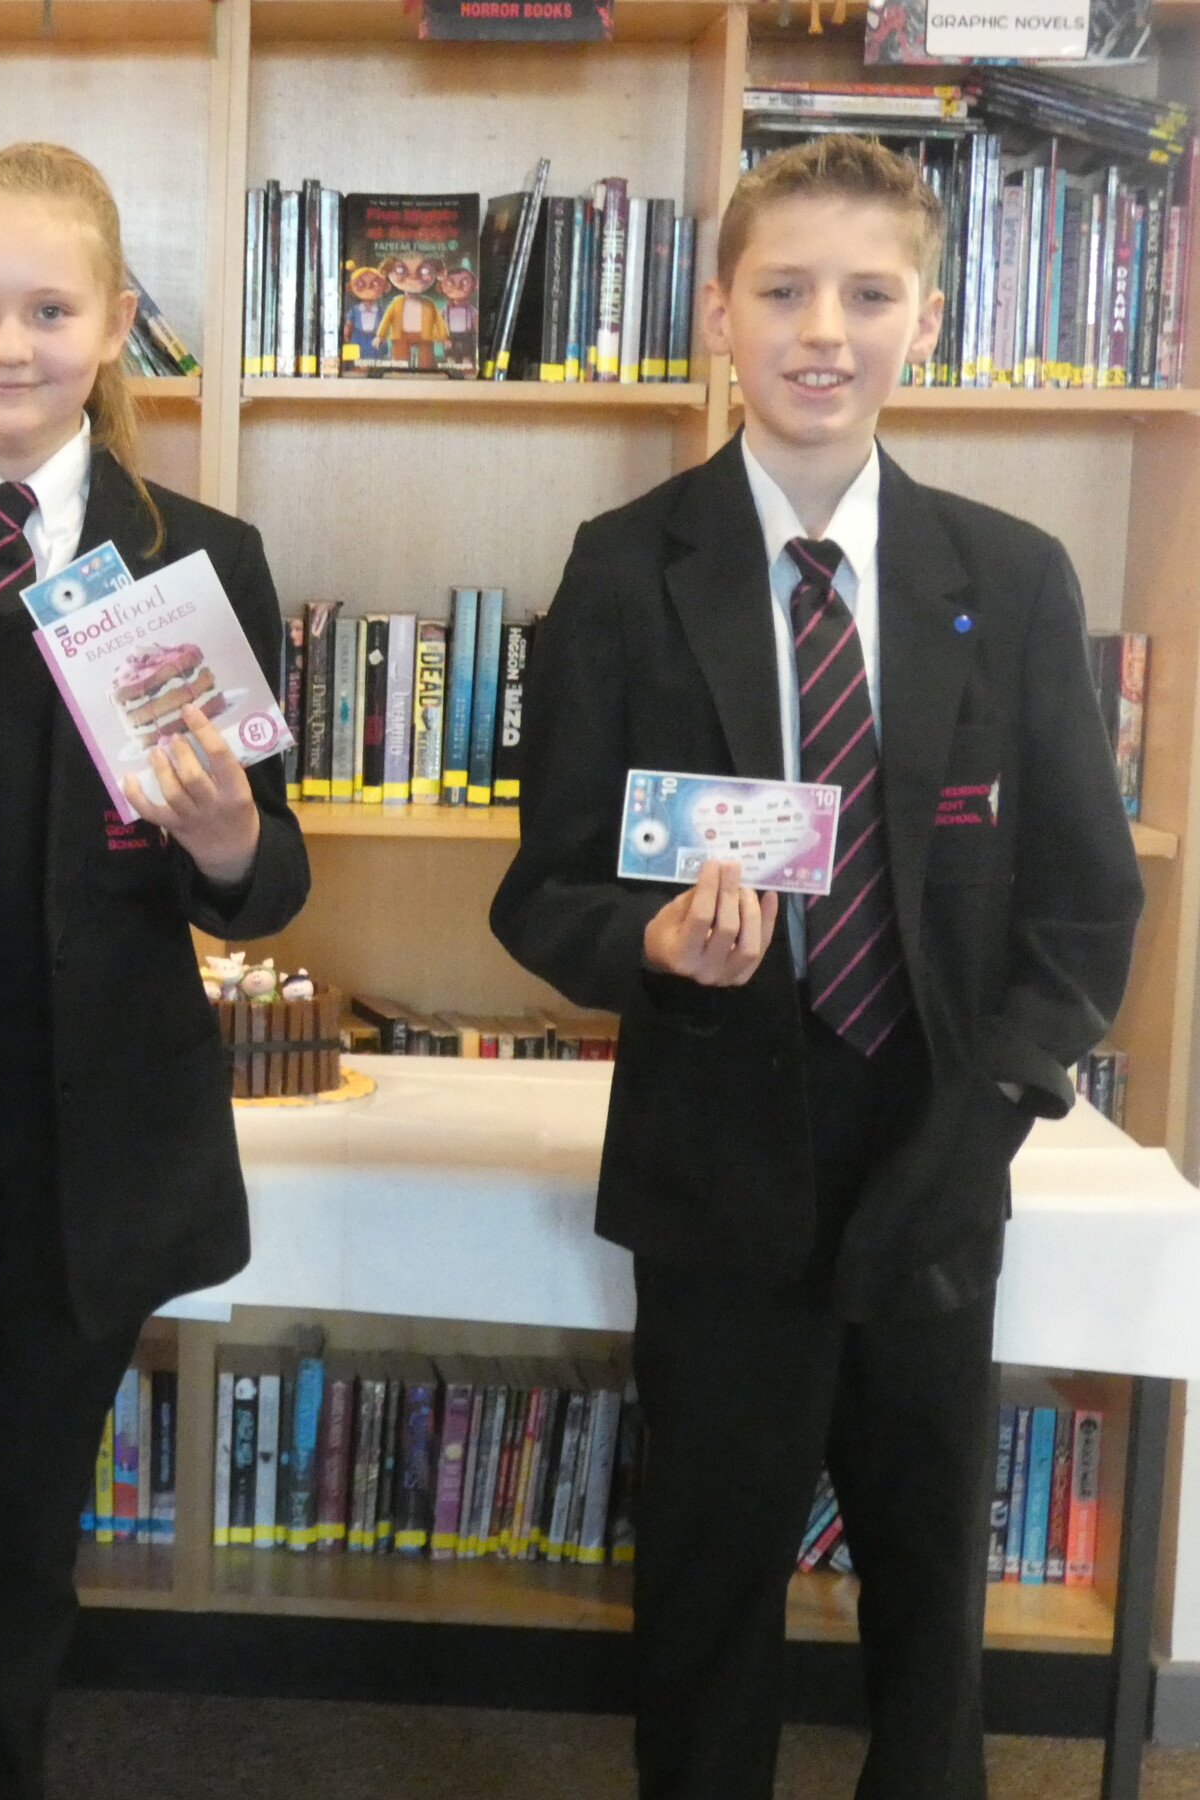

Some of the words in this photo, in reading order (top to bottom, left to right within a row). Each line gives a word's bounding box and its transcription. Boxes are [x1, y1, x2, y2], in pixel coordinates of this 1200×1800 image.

[461, 3, 519, 17] HORROR
[524, 4, 572, 18] BOOKS
[931, 15, 1008, 29] GRAPHIC
[1015, 15, 1084, 29] NOVELS
[601, 228, 625, 258] THE
[1147, 213, 1161, 253] SCIENCE
[599, 262, 623, 324] FRENZY
[1145, 256, 1159, 291] TALES
[1113, 266, 1128, 332] DRAMA
[85, 631, 134, 663] BAKES
[136, 627, 146, 638] &
[147, 601, 196, 631] CAKES
[507, 628, 522, 680] HIGSON
[419, 652, 443, 707] DEAD
[307, 683, 326, 724] Dark
[310, 723, 325, 769] Divine
